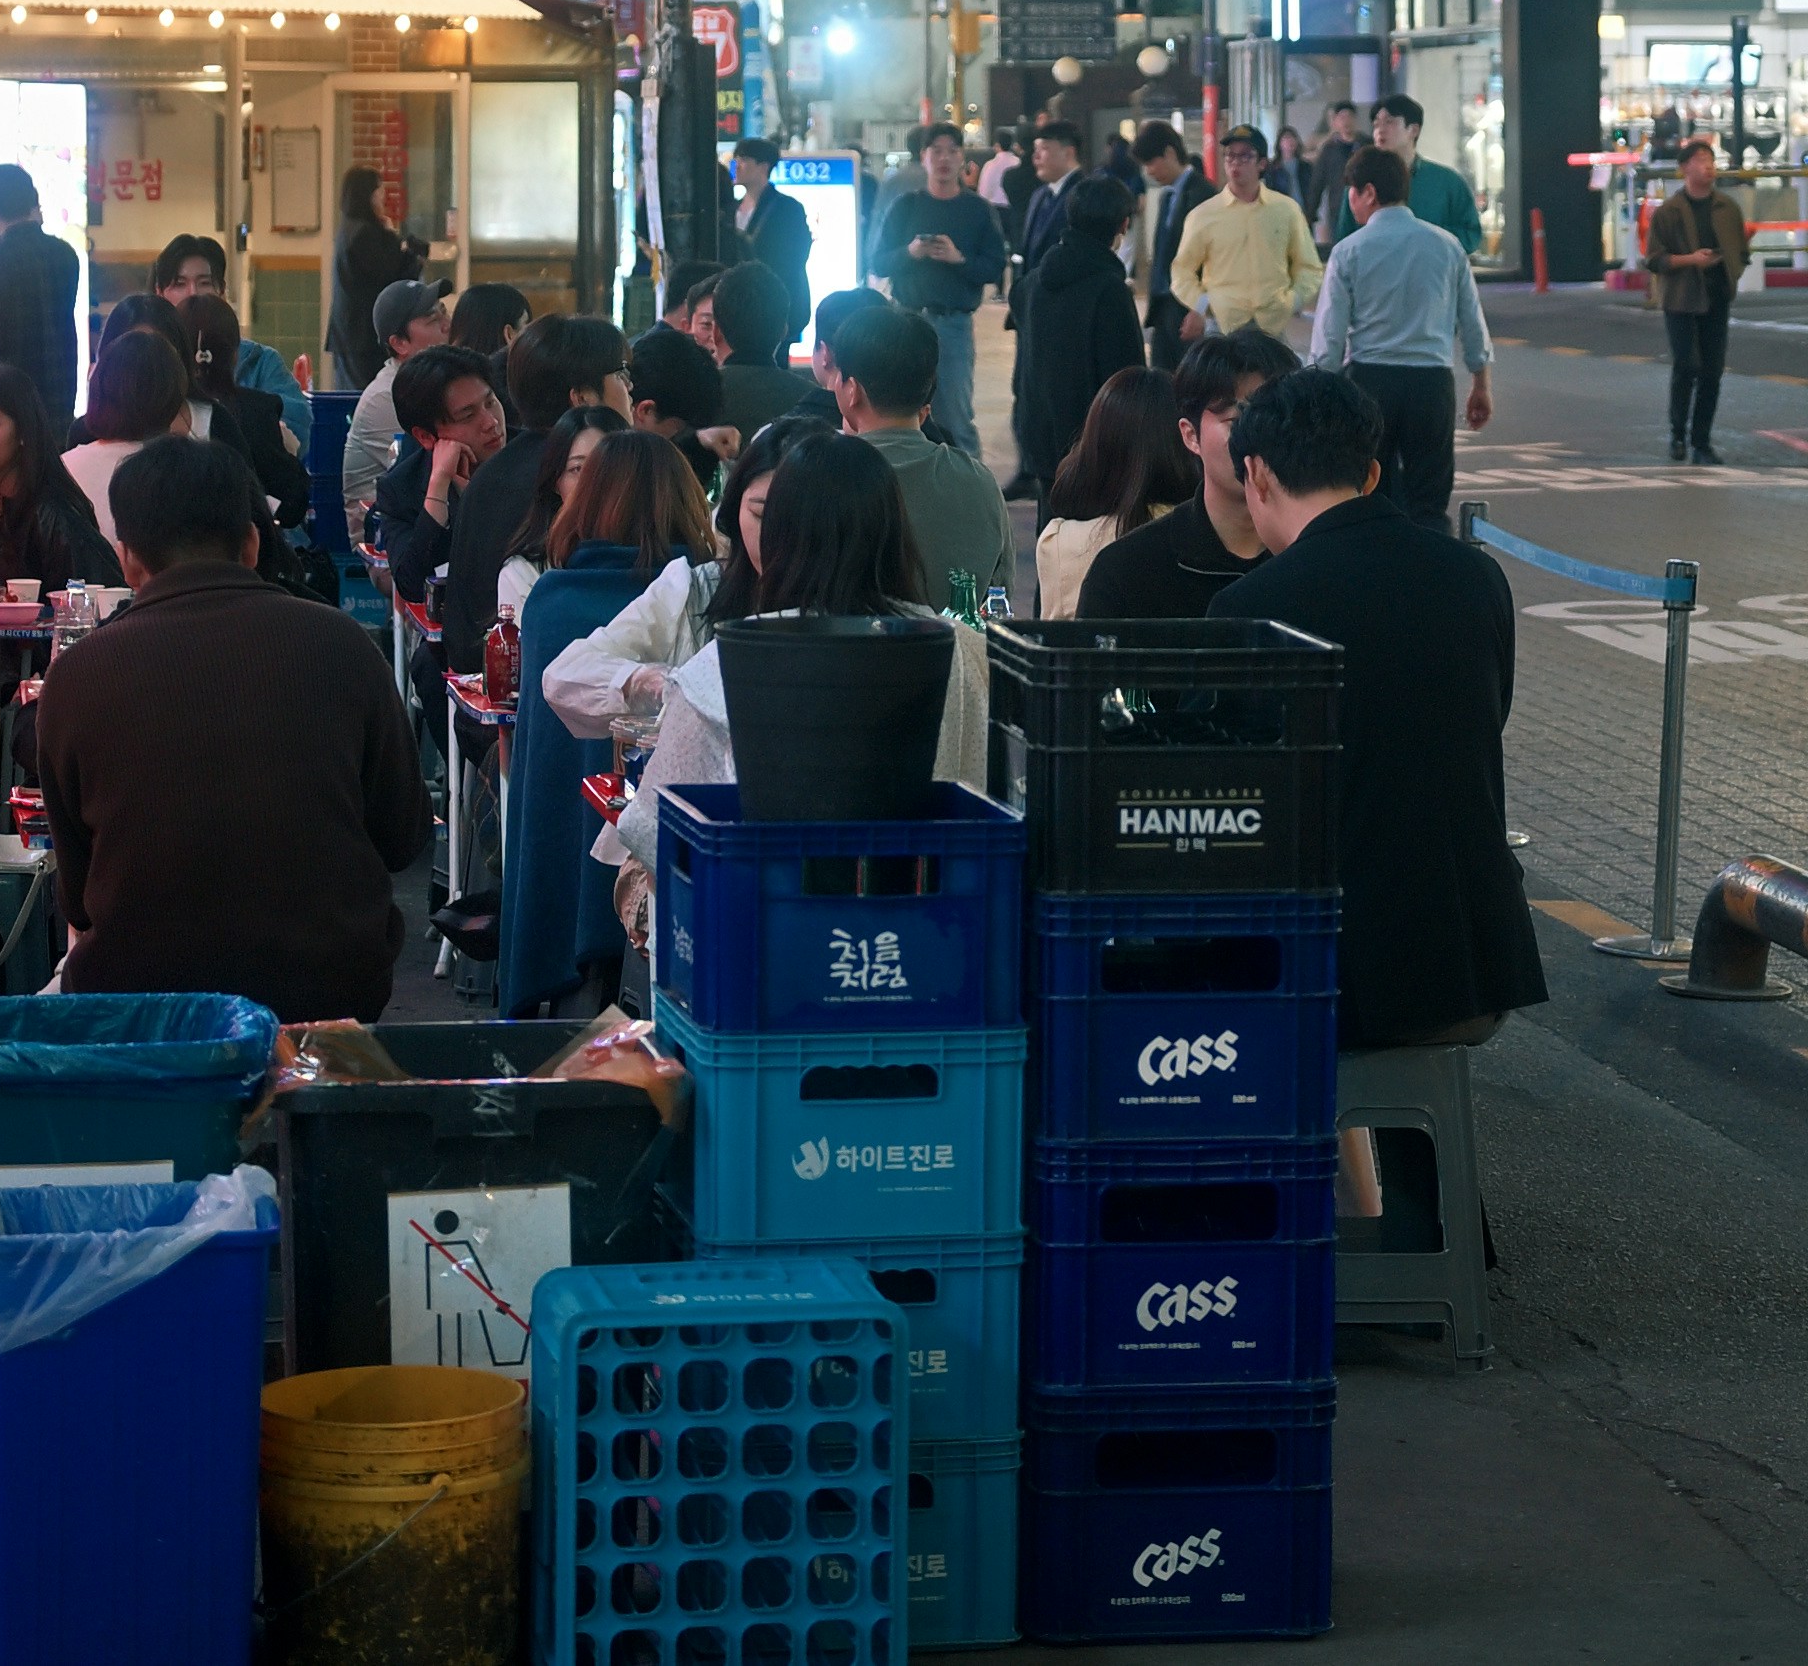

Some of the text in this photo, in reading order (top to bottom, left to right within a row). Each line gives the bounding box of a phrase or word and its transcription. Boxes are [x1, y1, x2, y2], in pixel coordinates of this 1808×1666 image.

[1119, 788, 1263, 800] KOREAN LAGER
[1120, 808, 1262, 834] HANMAC
[1138, 1030, 1240, 1086] Cass
[835, 1144, 955, 1172] 하이트진로
[1136, 1275, 1238, 1332] Cass
[1132, 1527, 1223, 1588] Cass
